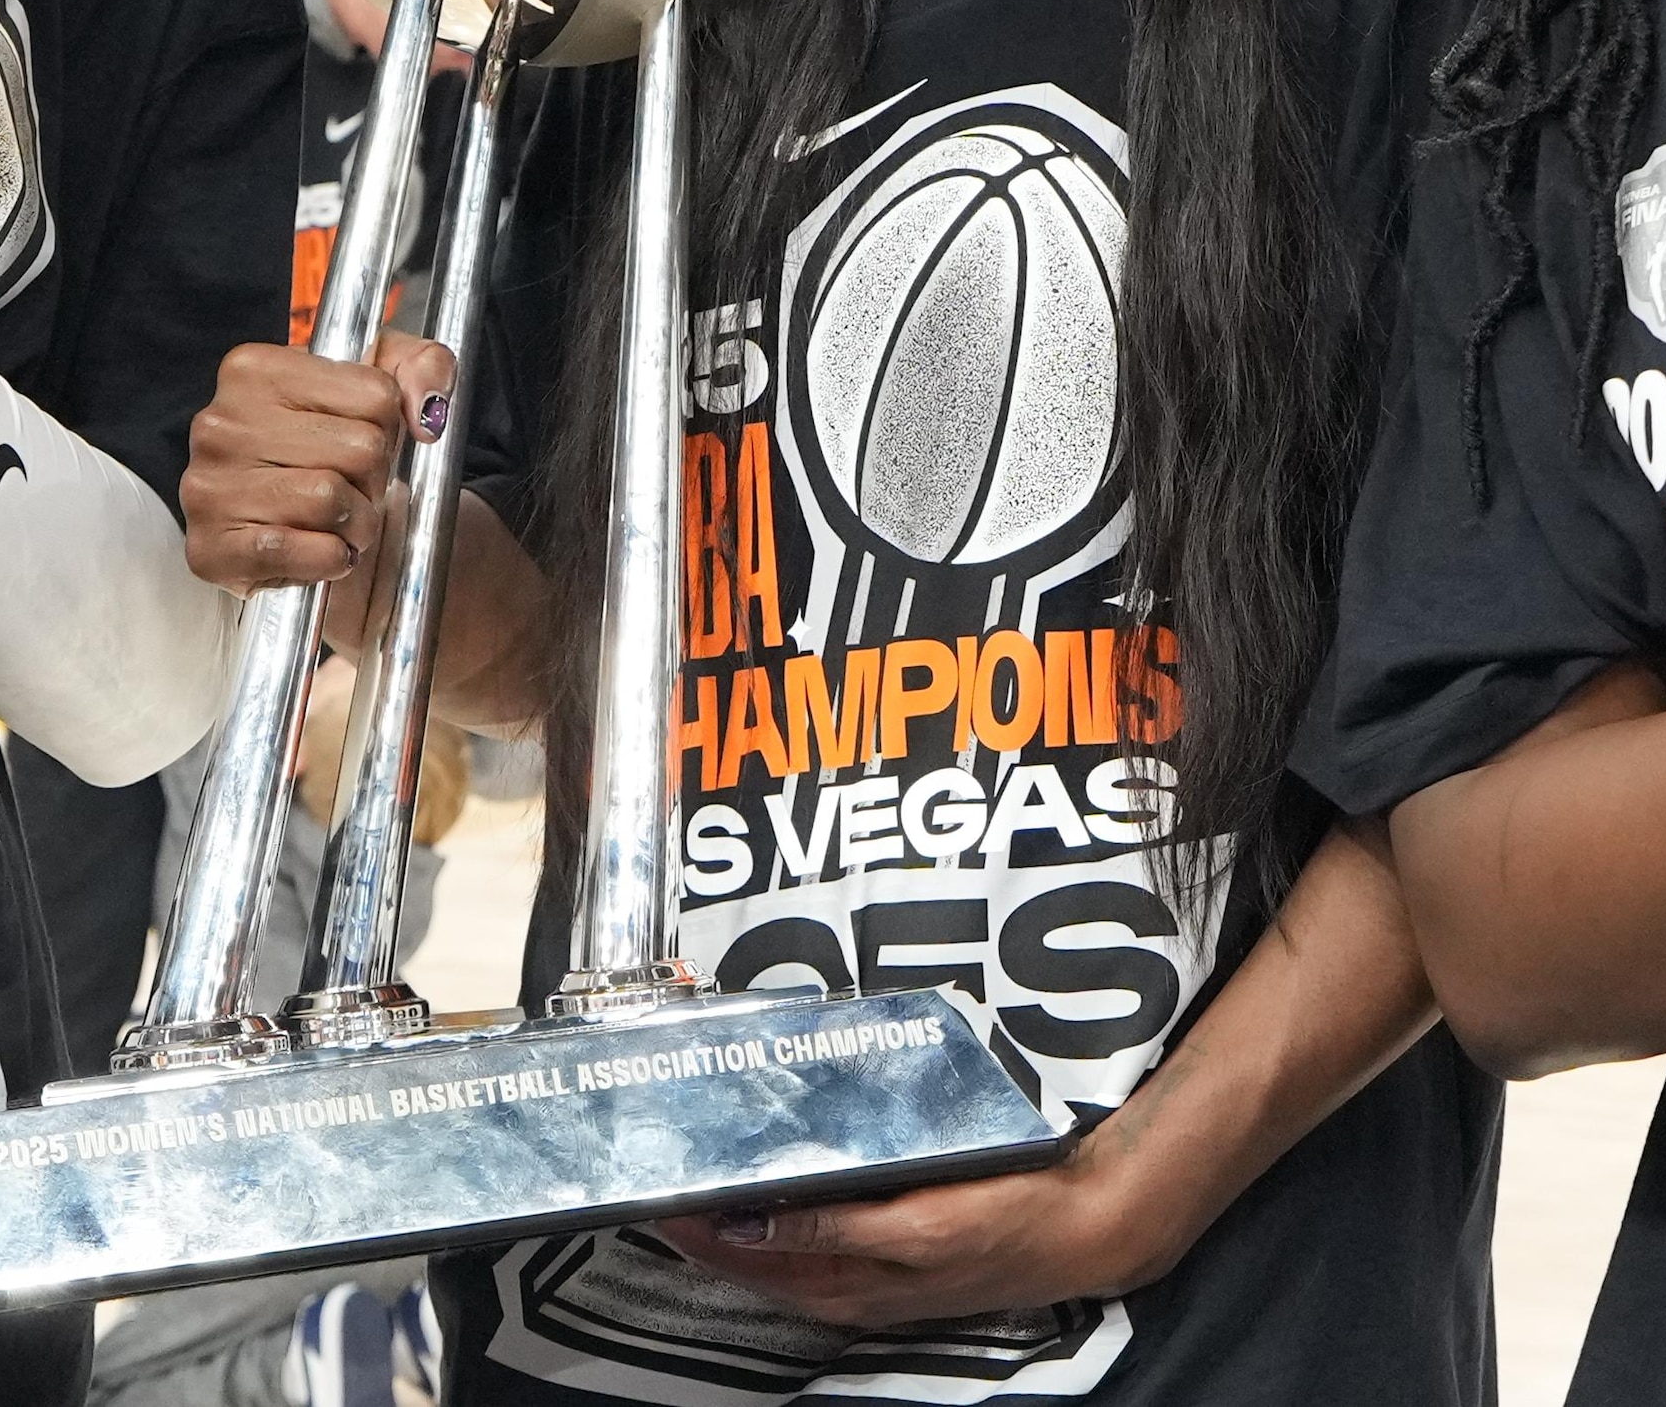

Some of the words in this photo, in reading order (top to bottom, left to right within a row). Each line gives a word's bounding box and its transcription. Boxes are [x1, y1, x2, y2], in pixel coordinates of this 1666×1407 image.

[1621, 182, 1662, 206] WNBA
[683, 421, 784, 660] BA
[667, 628, 1185, 793] HAMPIONS
[764, 756, 1182, 879] VEGAS
[74, 1112, 226, 1160] WOMEN'S
[233, 1091, 384, 1139] NATIONAL
[389, 1068, 571, 1118] BASKETBALL
[576, 1038, 767, 1093] ASSOCIATION
[774, 1016, 946, 1067] CHAMPIONS
